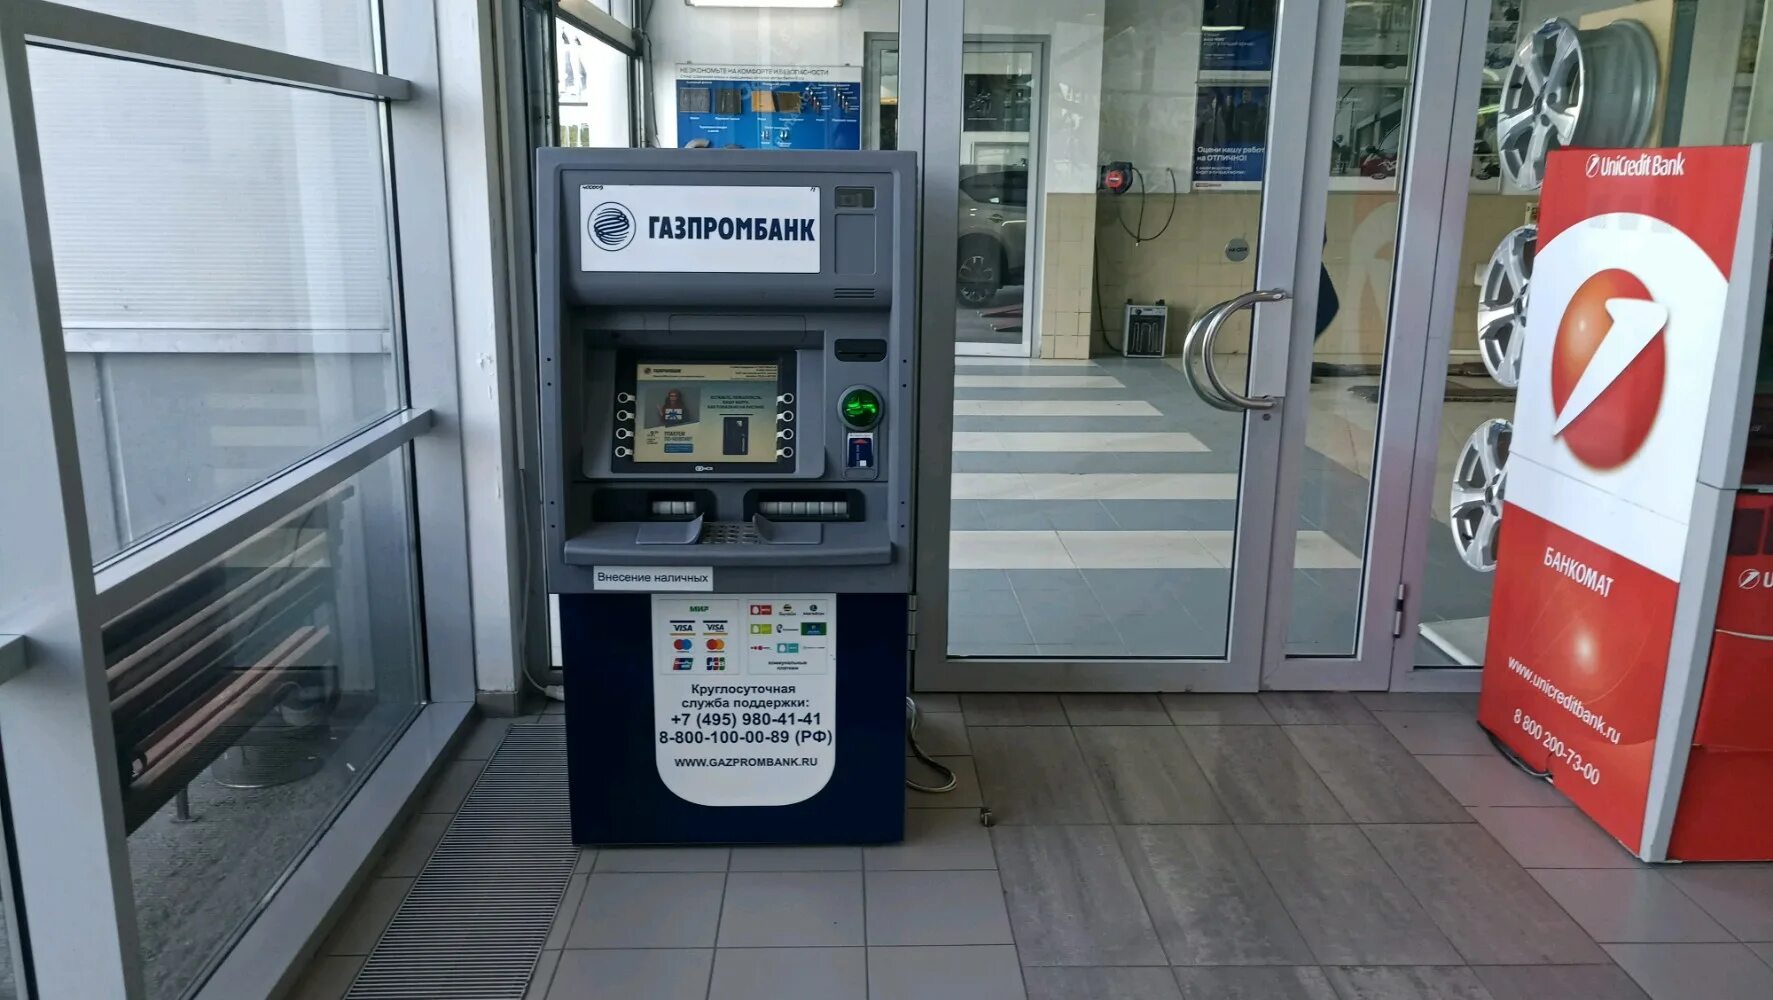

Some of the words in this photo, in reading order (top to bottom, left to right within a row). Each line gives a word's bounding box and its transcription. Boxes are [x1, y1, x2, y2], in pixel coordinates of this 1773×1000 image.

[1197, 146, 1221, 154] Оцени
[1242, 146, 1265, 154] работ
[1601, 153, 1652, 177] UniCredit
[1652, 152, 1685, 176] Bank
[648, 216, 816, 242] ГАЗПРОМБАНК
[597, 571, 651, 582] Внесение
[654, 574, 709, 583] наличных
[1543, 546, 1614, 598] БАНКОМАТ
[672, 624, 694, 632] VISA
[705, 623, 725, 631] VISA
[691, 684, 796, 696] Круглосуточная
[681, 697, 730, 711] служба
[733, 698, 810, 709] поддержки:
[1507, 655, 1621, 745] www.unicreditbank.ru
[671, 713, 691, 726] +7
[696, 713, 737, 728] (495)
[742, 712, 821, 725] 980-41-41
[659, 731, 790, 744] 8-800-100-00-89
[795, 730, 833, 746] (РФ)
[1513, 708, 1522, 725] 8
[1522, 715, 1542, 741] 800
[1542, 731, 1601, 786] 200-73-00
[674, 757, 819, 767] WWW.GAZPROMBANK.RU
